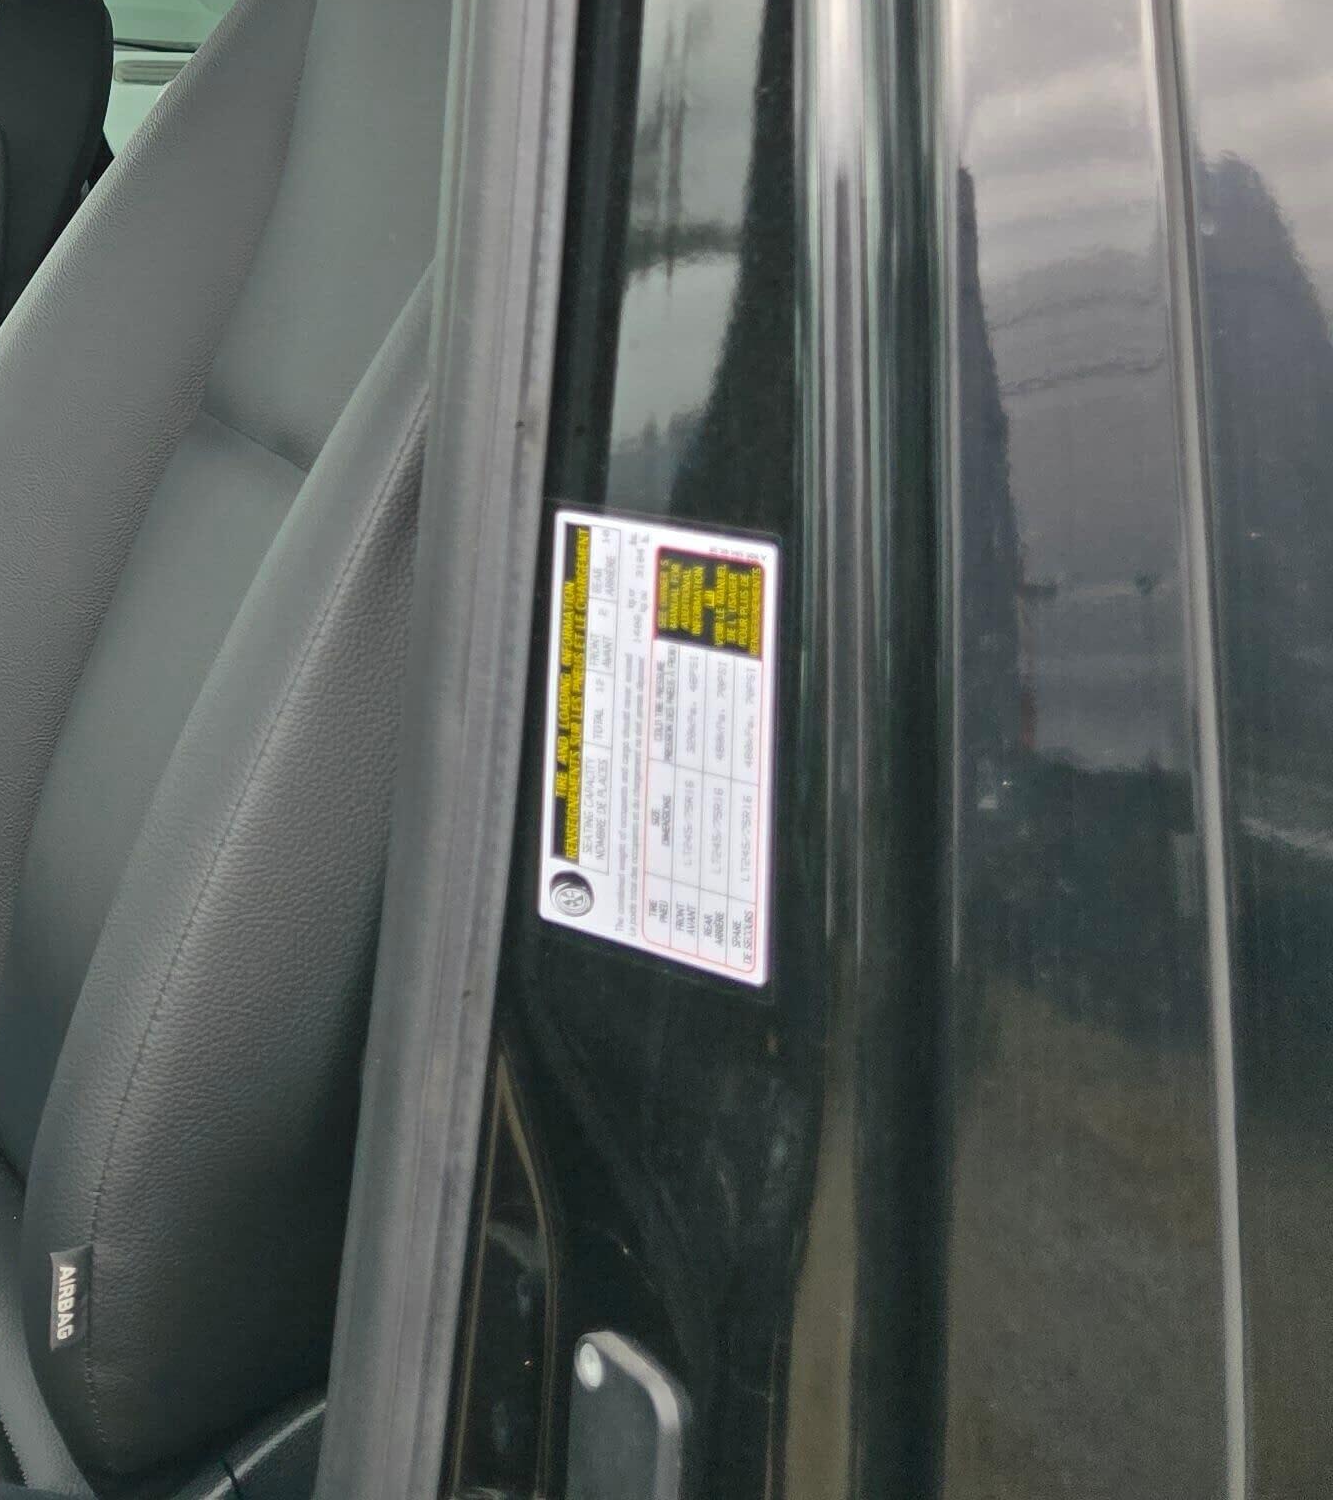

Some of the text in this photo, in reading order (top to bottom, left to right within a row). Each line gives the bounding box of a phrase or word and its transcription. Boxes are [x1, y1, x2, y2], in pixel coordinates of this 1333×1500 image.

[575, 528, 590, 610] CHARGEMENT
[575, 614, 586, 629] LE
[692, 565, 703, 635] INFORMATION
[555, 580, 574, 798] TIRE AND LOADING INFORMATION
[572, 651, 585, 694] PNEUS
[571, 694, 582, 718] LES
[592, 706, 603, 741] TOTAL
[569, 721, 582, 746] SUR
[596, 758, 608, 798] PLACES
[564, 749, 581, 860] RENSEIGNEMENTS
[582, 756, 595, 854] SEATING CAPACITY
[594, 817, 606, 861] NOMBRE
[56, 1266, 77, 1341] AIRBAG
